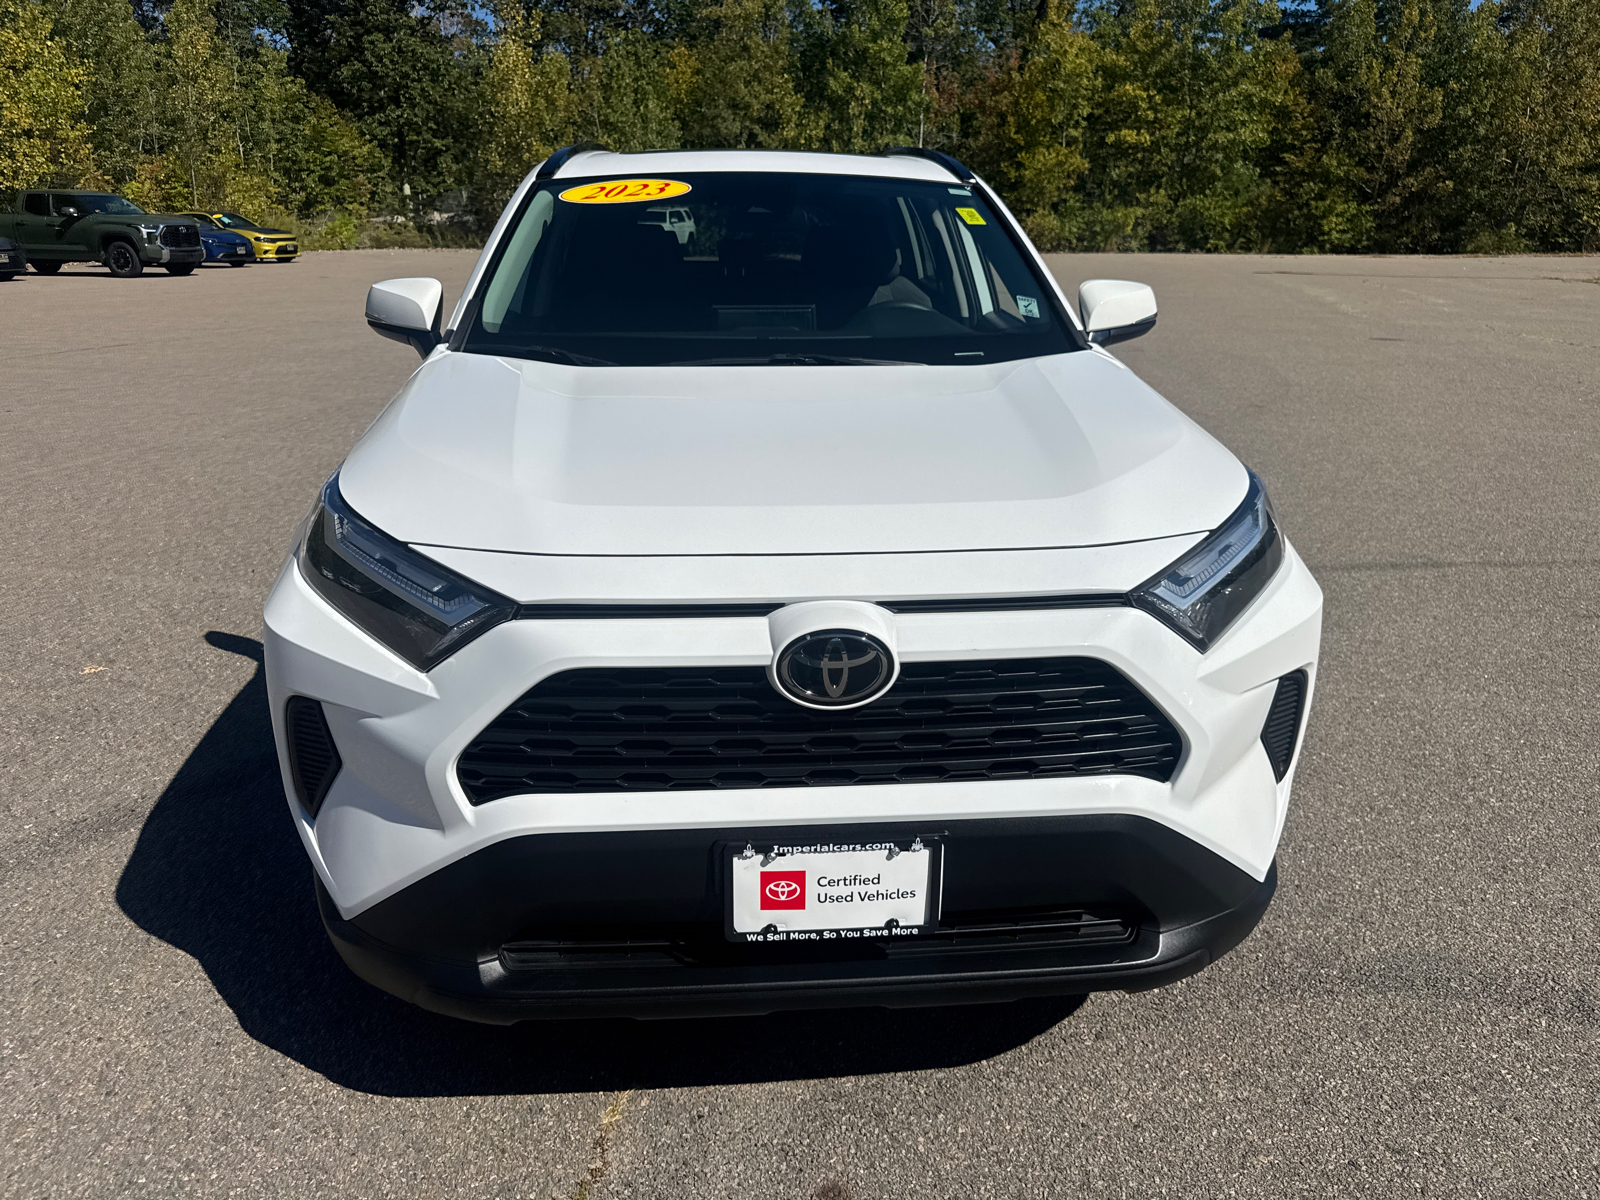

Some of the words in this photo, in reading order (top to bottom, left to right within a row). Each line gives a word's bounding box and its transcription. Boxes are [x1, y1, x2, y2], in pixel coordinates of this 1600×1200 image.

[580, 183, 671, 200] 2023
[773, 842, 895, 853] Imperialcars.com
[817, 873, 881, 887] Certified
[817, 891, 854, 904] Used
[858, 888, 916, 902] Vehicles
[746, 933, 764, 942] We
[766, 932, 787, 941] Sell
[789, 930, 820, 941] More,
[822, 930, 837, 939] So
[839, 929, 861, 938] You
[863, 928, 890, 937] Save
[891, 927, 919, 936] More
